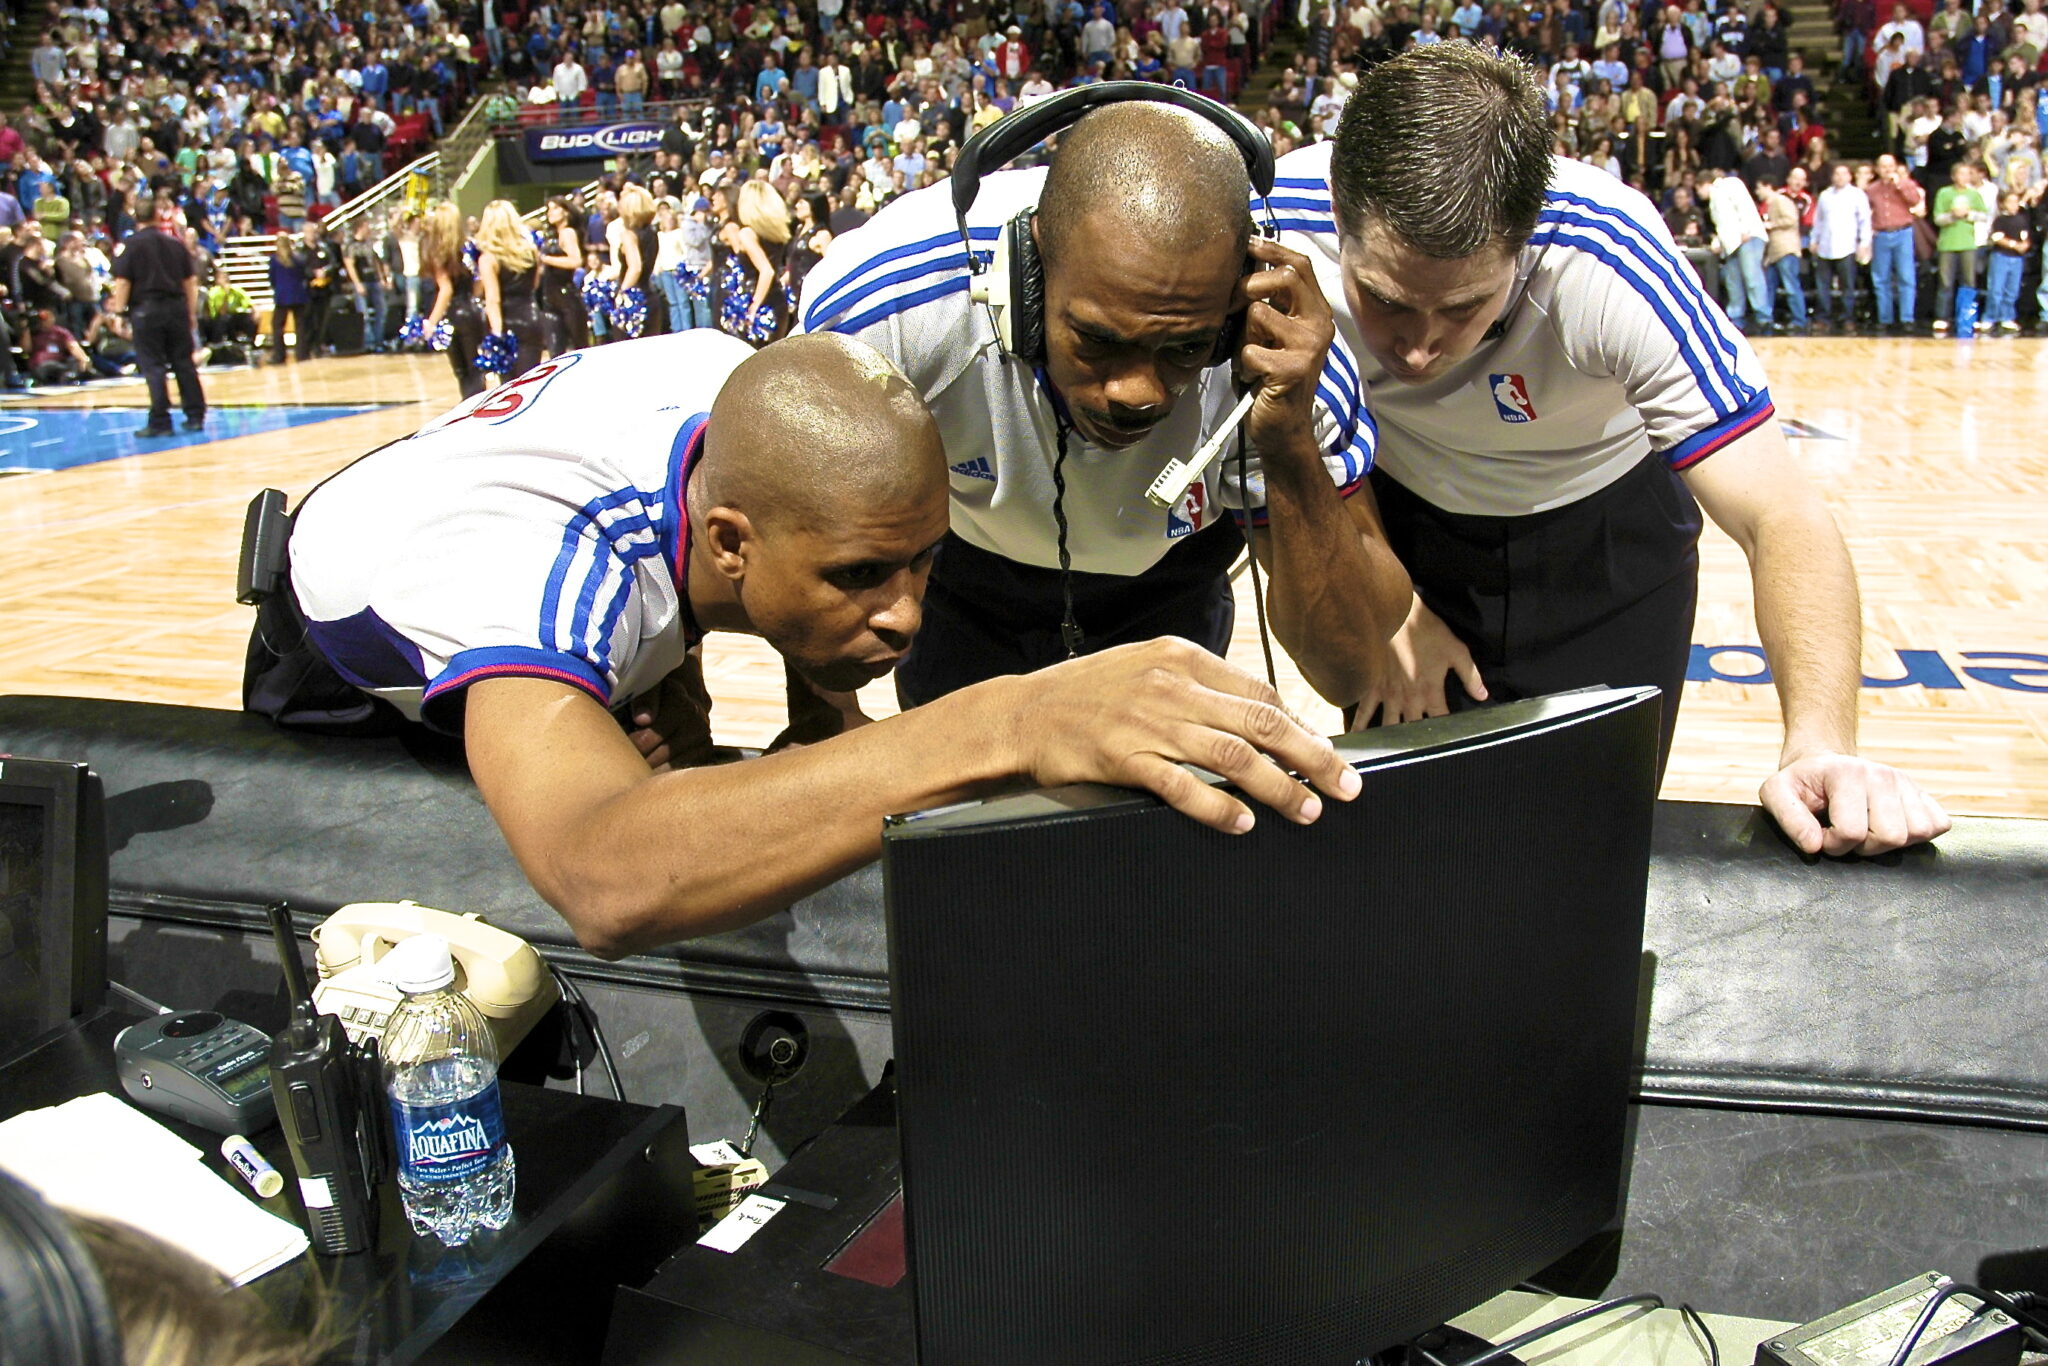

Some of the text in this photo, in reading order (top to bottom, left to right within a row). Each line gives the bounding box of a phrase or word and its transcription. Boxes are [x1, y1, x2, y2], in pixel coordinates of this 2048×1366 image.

[540, 130, 665, 150] BUD LIGH
[1503, 413, 1526, 421] NBA
[949, 464, 997, 482] adidas
[1170, 525, 1191, 537] NBA
[409, 1119, 490, 1163] AQUAFINA
